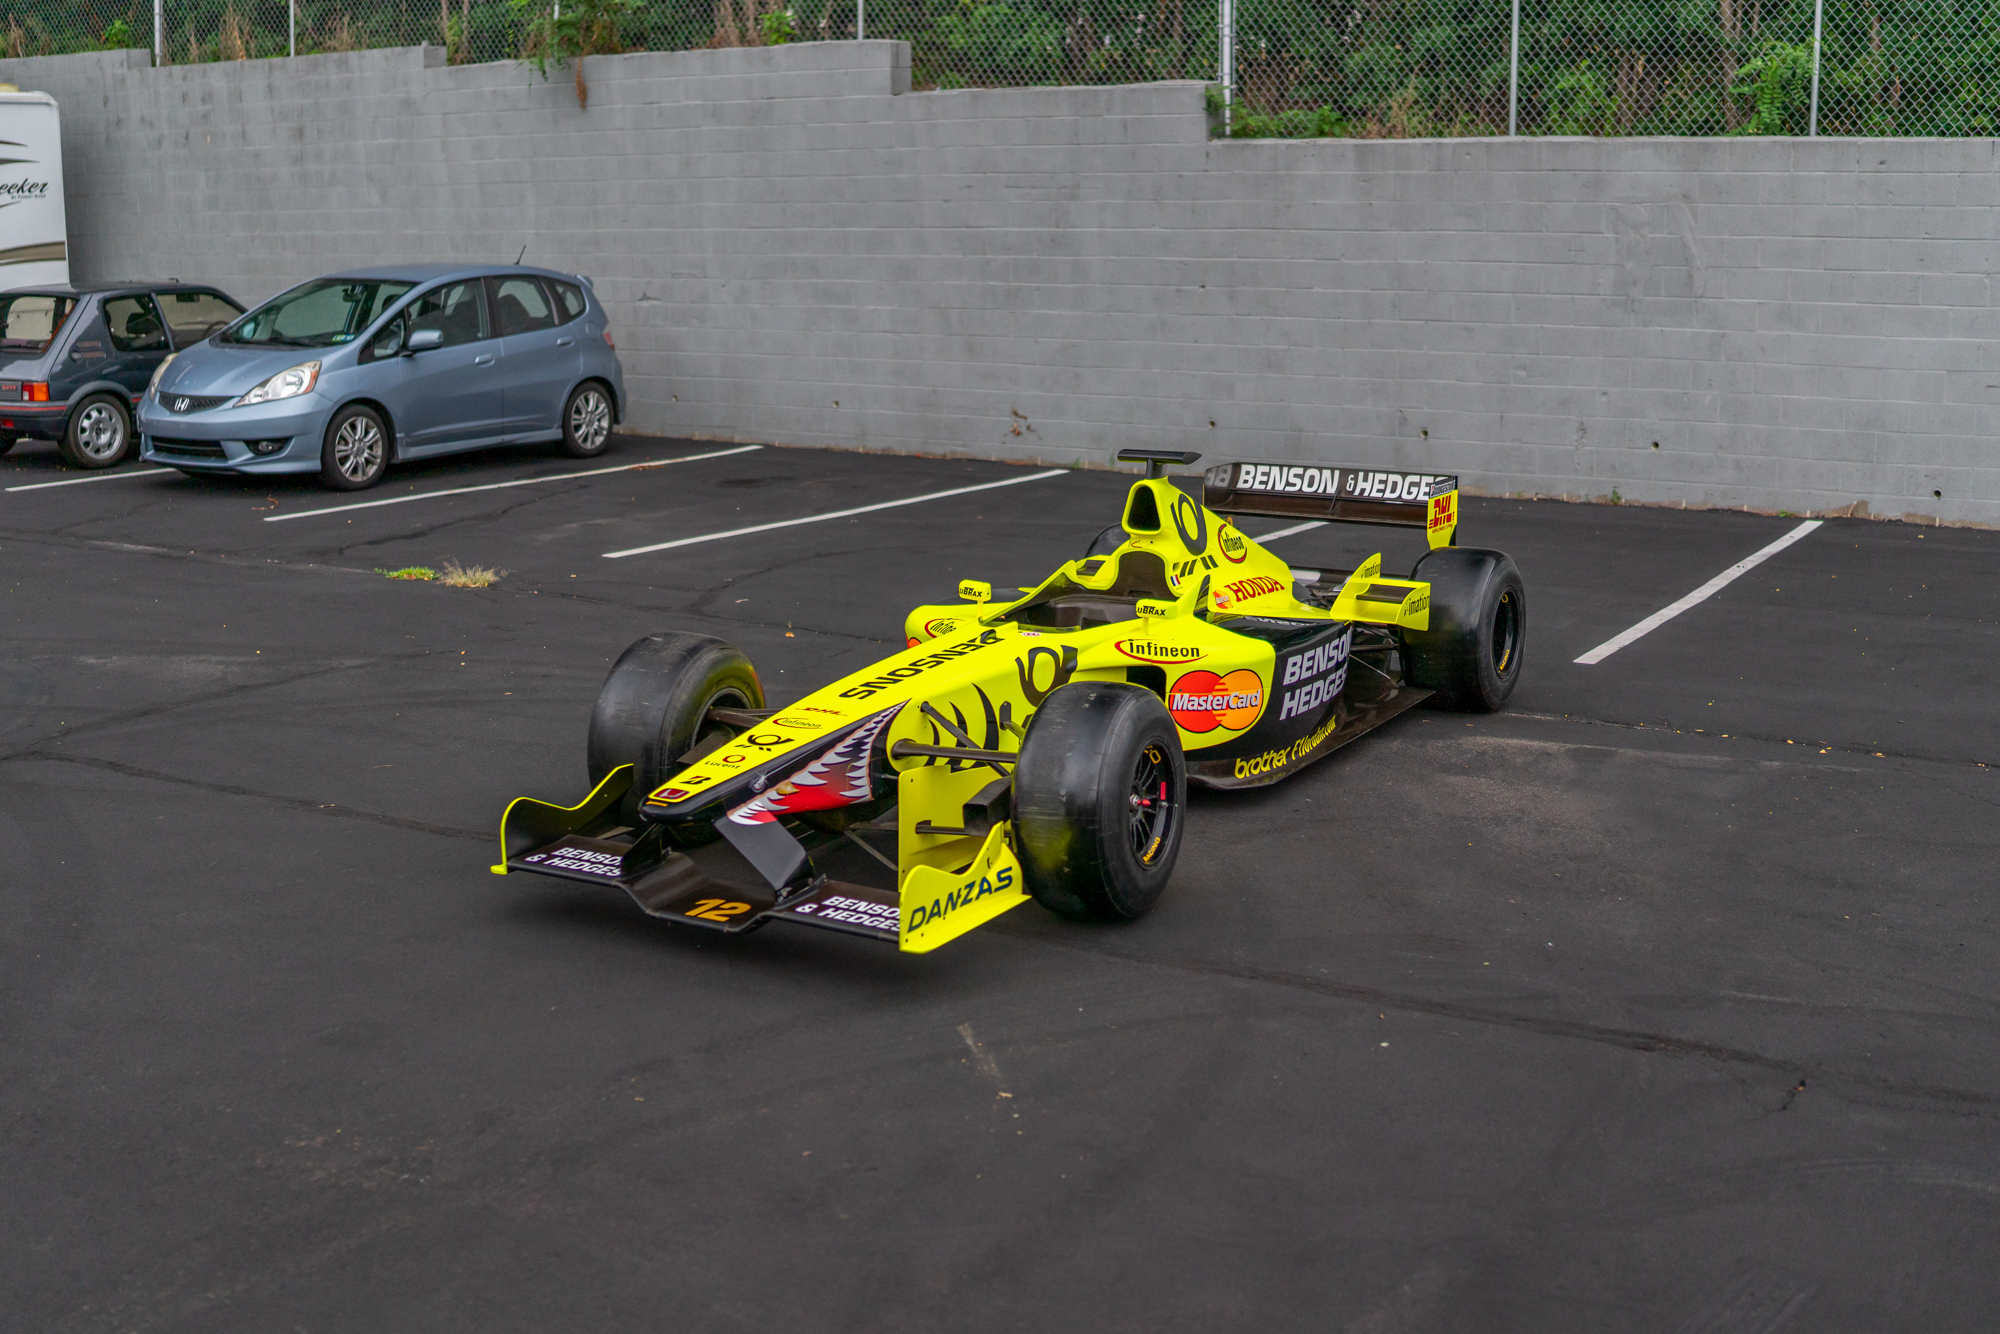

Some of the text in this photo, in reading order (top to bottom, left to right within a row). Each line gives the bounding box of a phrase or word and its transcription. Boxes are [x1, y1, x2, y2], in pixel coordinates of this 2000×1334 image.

[1236, 463, 1448, 501] BENSON & HEDGE
[1224, 576, 1285, 603] HONDA
[1283, 626, 1352, 686] BENSON
[1172, 688, 1261, 712] MasterCard
[1279, 661, 1348, 721] HEDGES
[705, 760, 741, 770] Lucent
[1234, 746, 1292, 779] brother
[525, 853, 548, 863] &
[684, 898, 752, 922] 12
[795, 903, 819, 914] &
[821, 895, 900, 919] BENSO
[907, 866, 1013, 934] DANZAS
